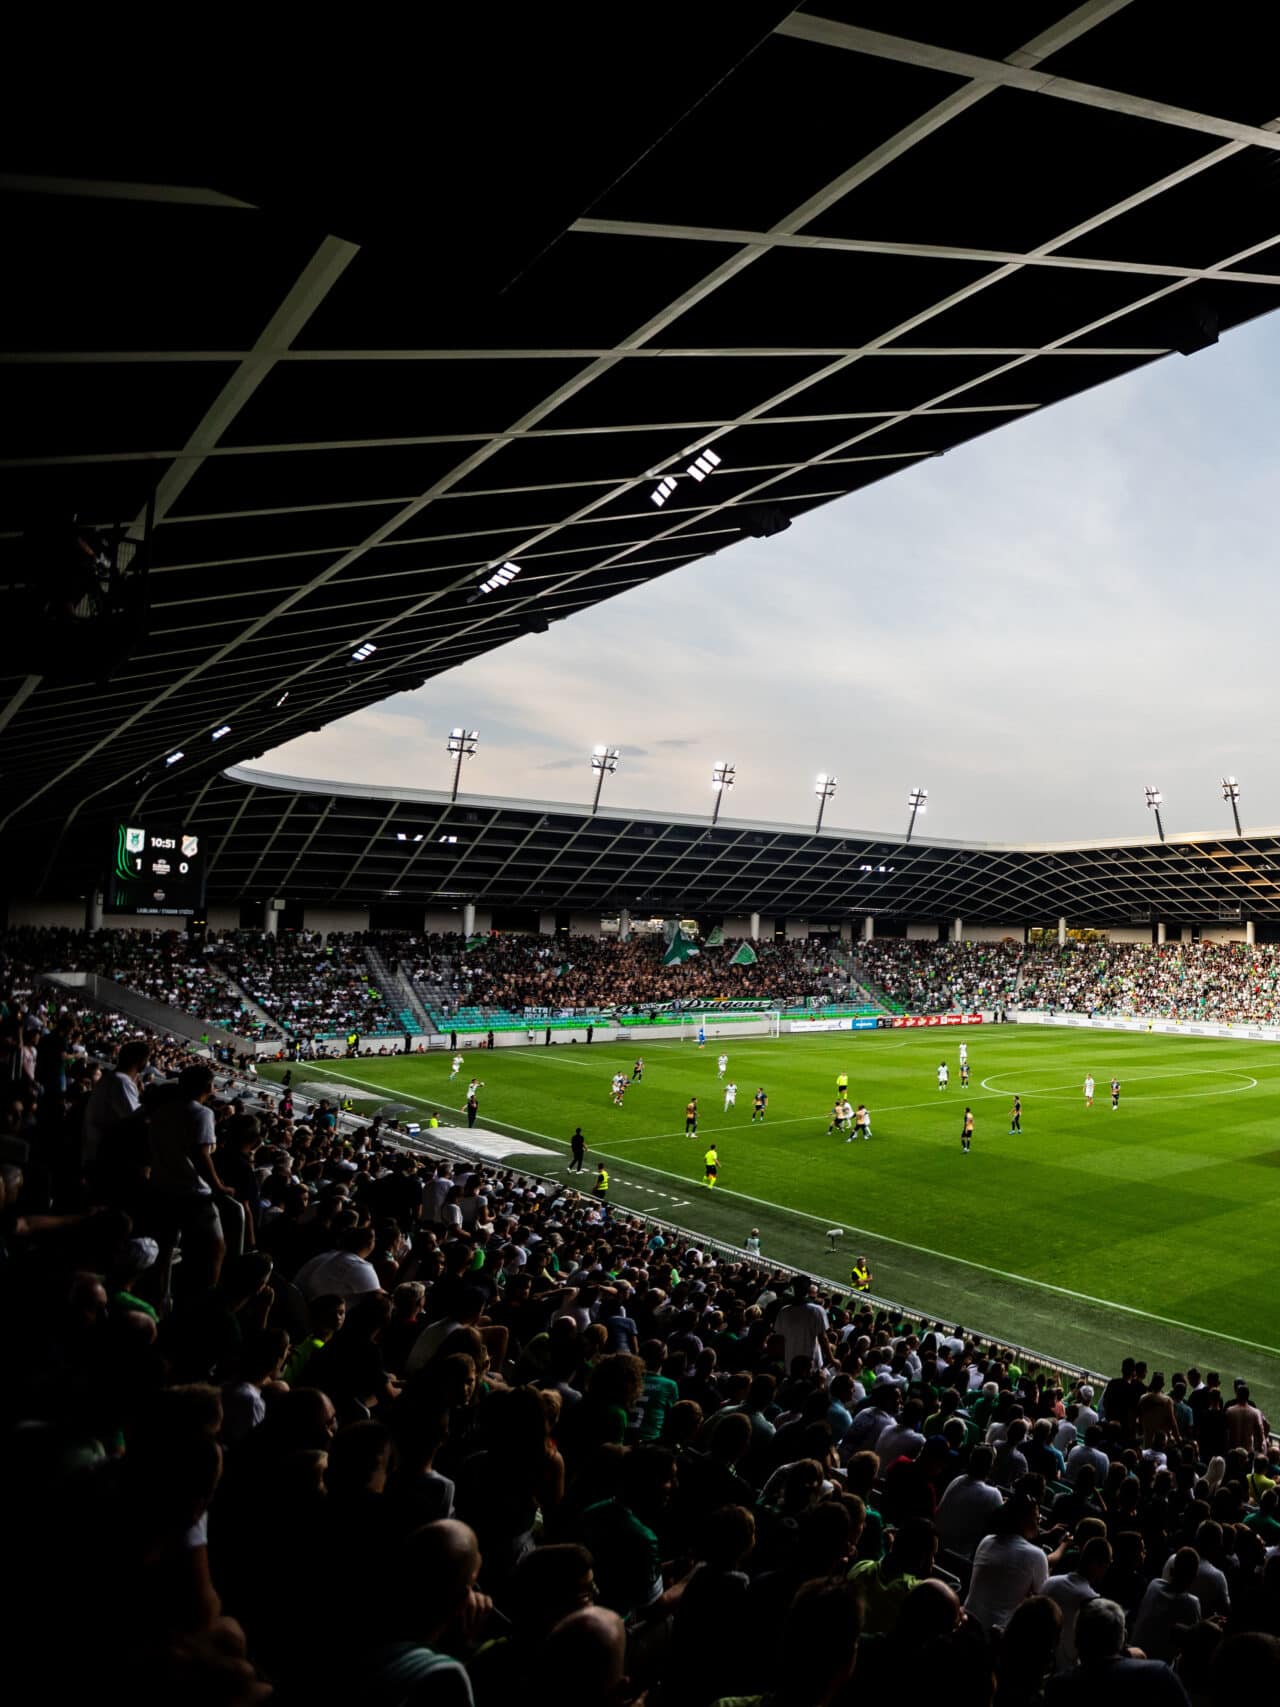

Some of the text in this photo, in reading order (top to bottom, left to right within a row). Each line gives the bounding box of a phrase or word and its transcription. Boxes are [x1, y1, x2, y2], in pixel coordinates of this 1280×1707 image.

[151, 837, 176, 849] 10:51
[136, 859, 142, 870] 1
[179, 862, 189, 874] 0
[684, 998, 765, 1011] Dragons
